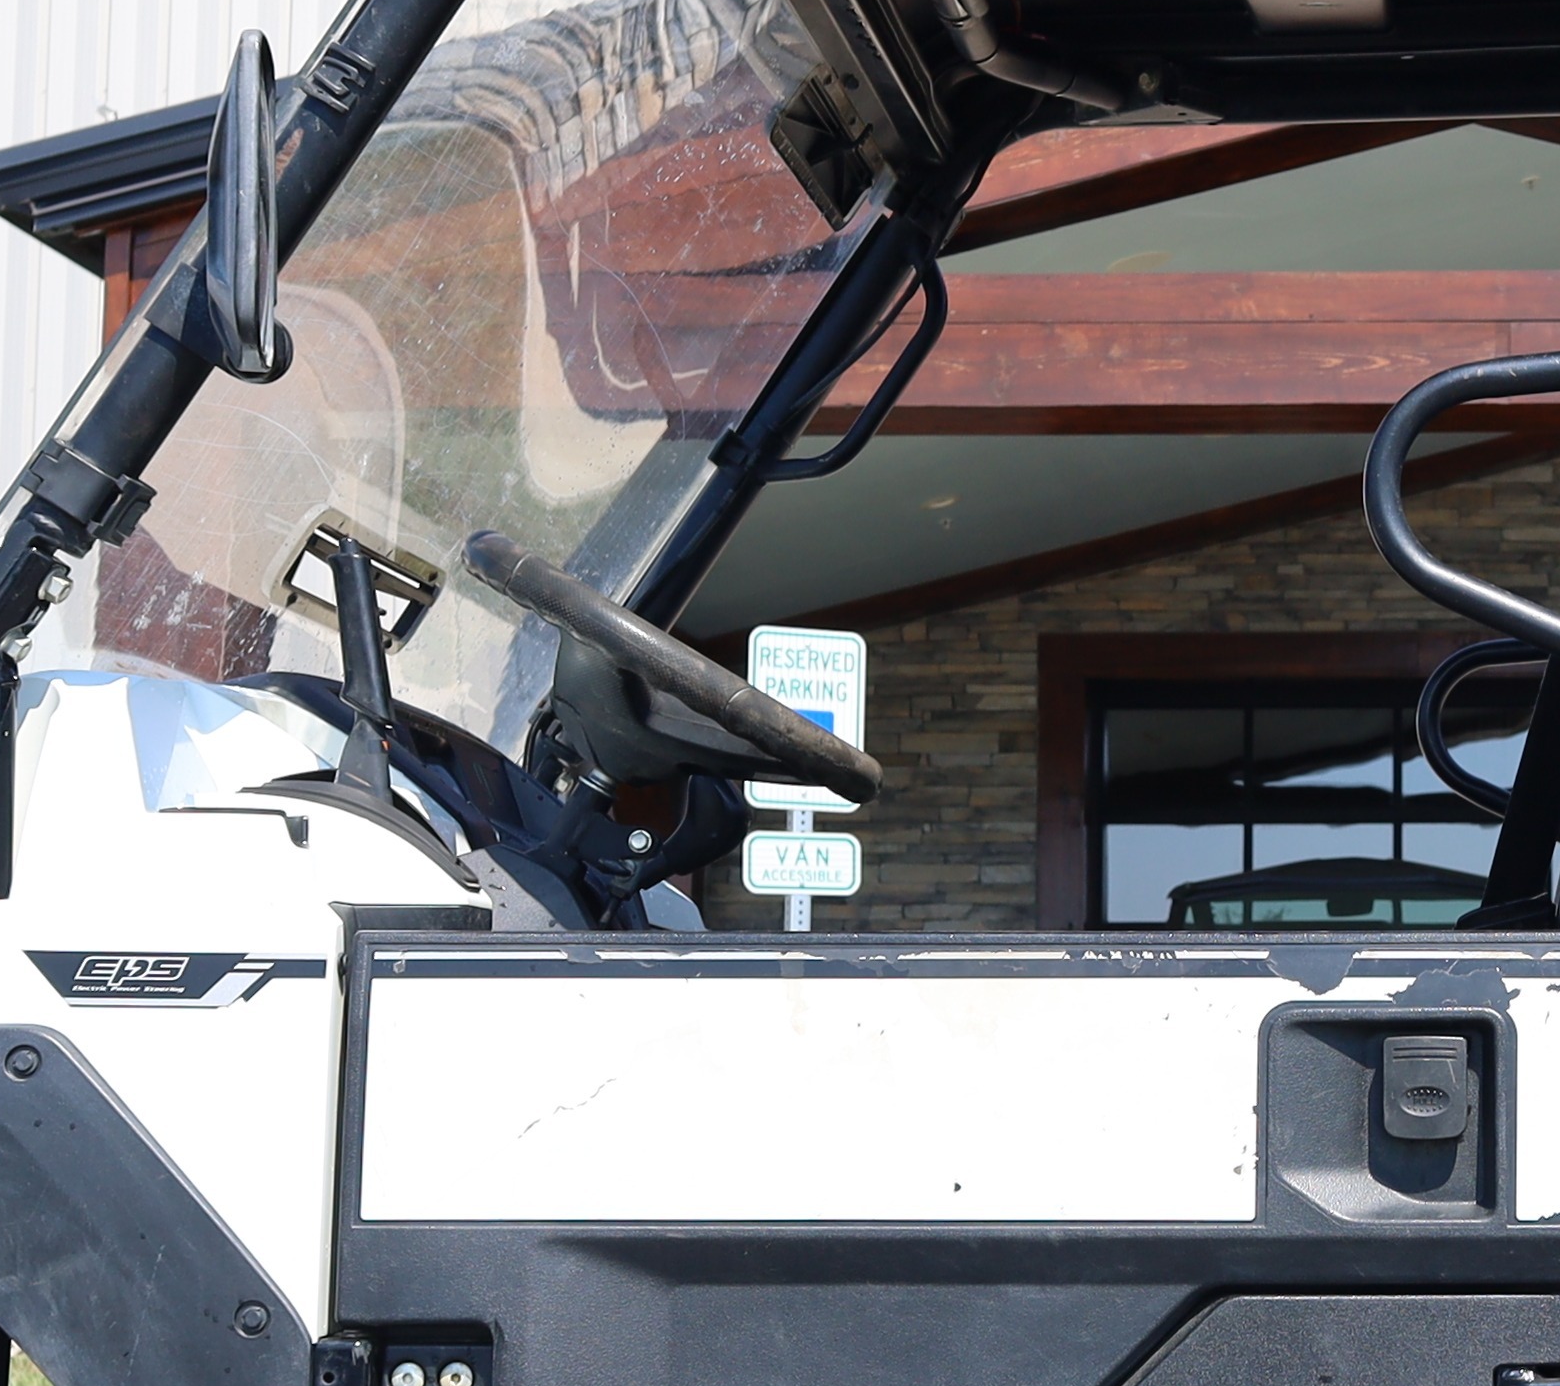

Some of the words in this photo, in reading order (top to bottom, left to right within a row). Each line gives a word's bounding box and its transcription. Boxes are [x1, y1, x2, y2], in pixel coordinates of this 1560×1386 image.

[760, 646, 855, 673] RESERVED
[765, 677, 847, 702] PARKING
[775, 844, 829, 866] VAN
[762, 869, 842, 883] ACCESSIBLE
[144, 986, 186, 994] Steering
